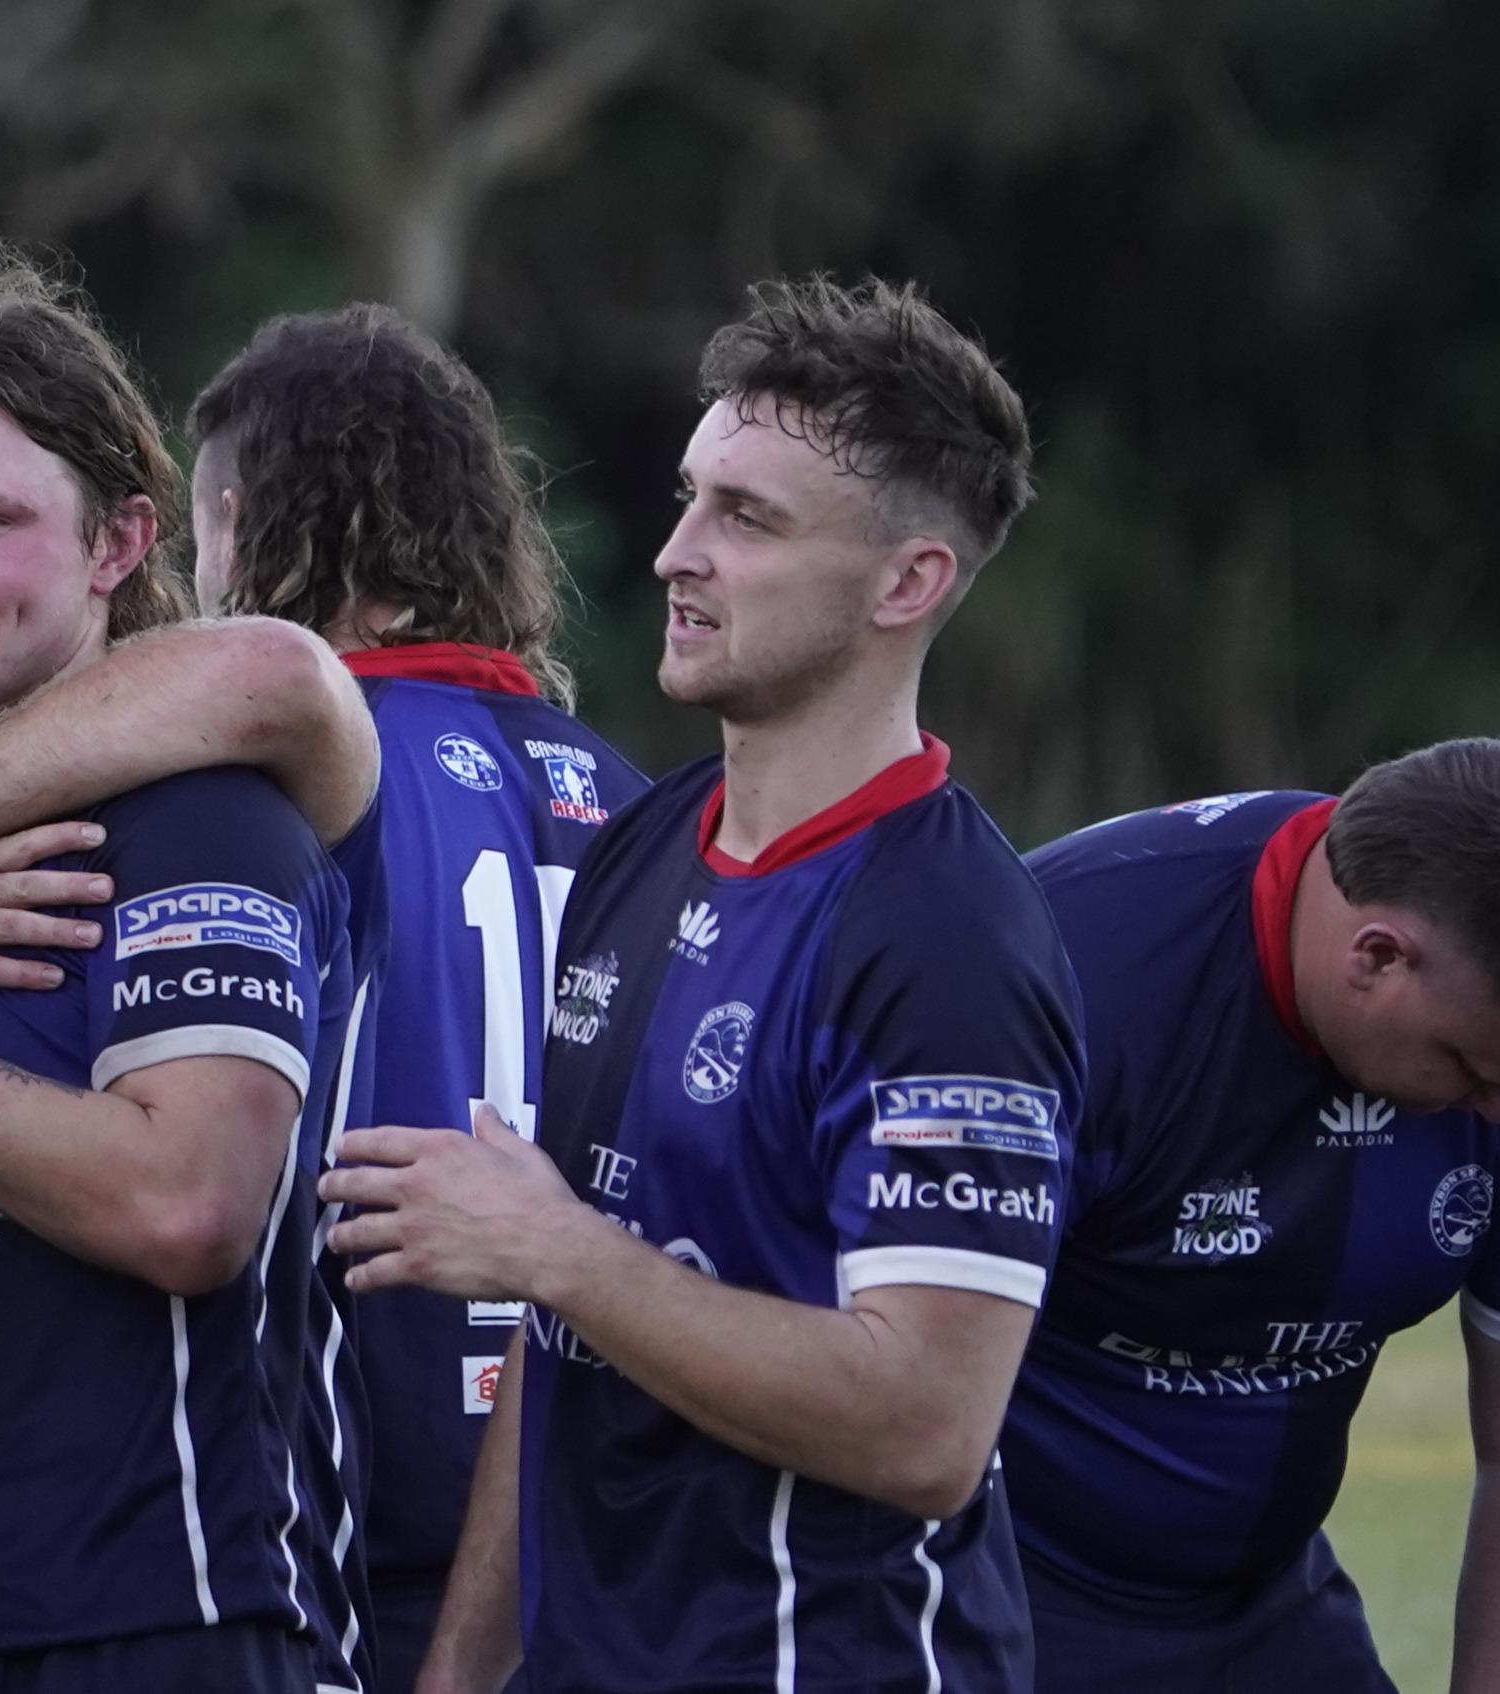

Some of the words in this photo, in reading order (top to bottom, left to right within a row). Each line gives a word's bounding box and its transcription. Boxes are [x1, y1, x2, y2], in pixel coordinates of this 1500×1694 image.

[524, 739, 597, 771] BANGALOW
[551, 800, 609, 825] REBELS
[127, 933, 194, 952] Project
[113, 967, 304, 1020] McGrath
[558, 964, 621, 1009] STONE
[551, 1004, 600, 1045] WOOD
[1315, 1133, 1395, 1148] PALADIN
[868, 1171, 1055, 1226] McGrath
[1178, 1186, 1261, 1221] STONE
[1171, 1226, 1263, 1256] WOOD
[1266, 1320, 1363, 1355] THE
[1143, 1341, 1378, 1397] BANGALO
